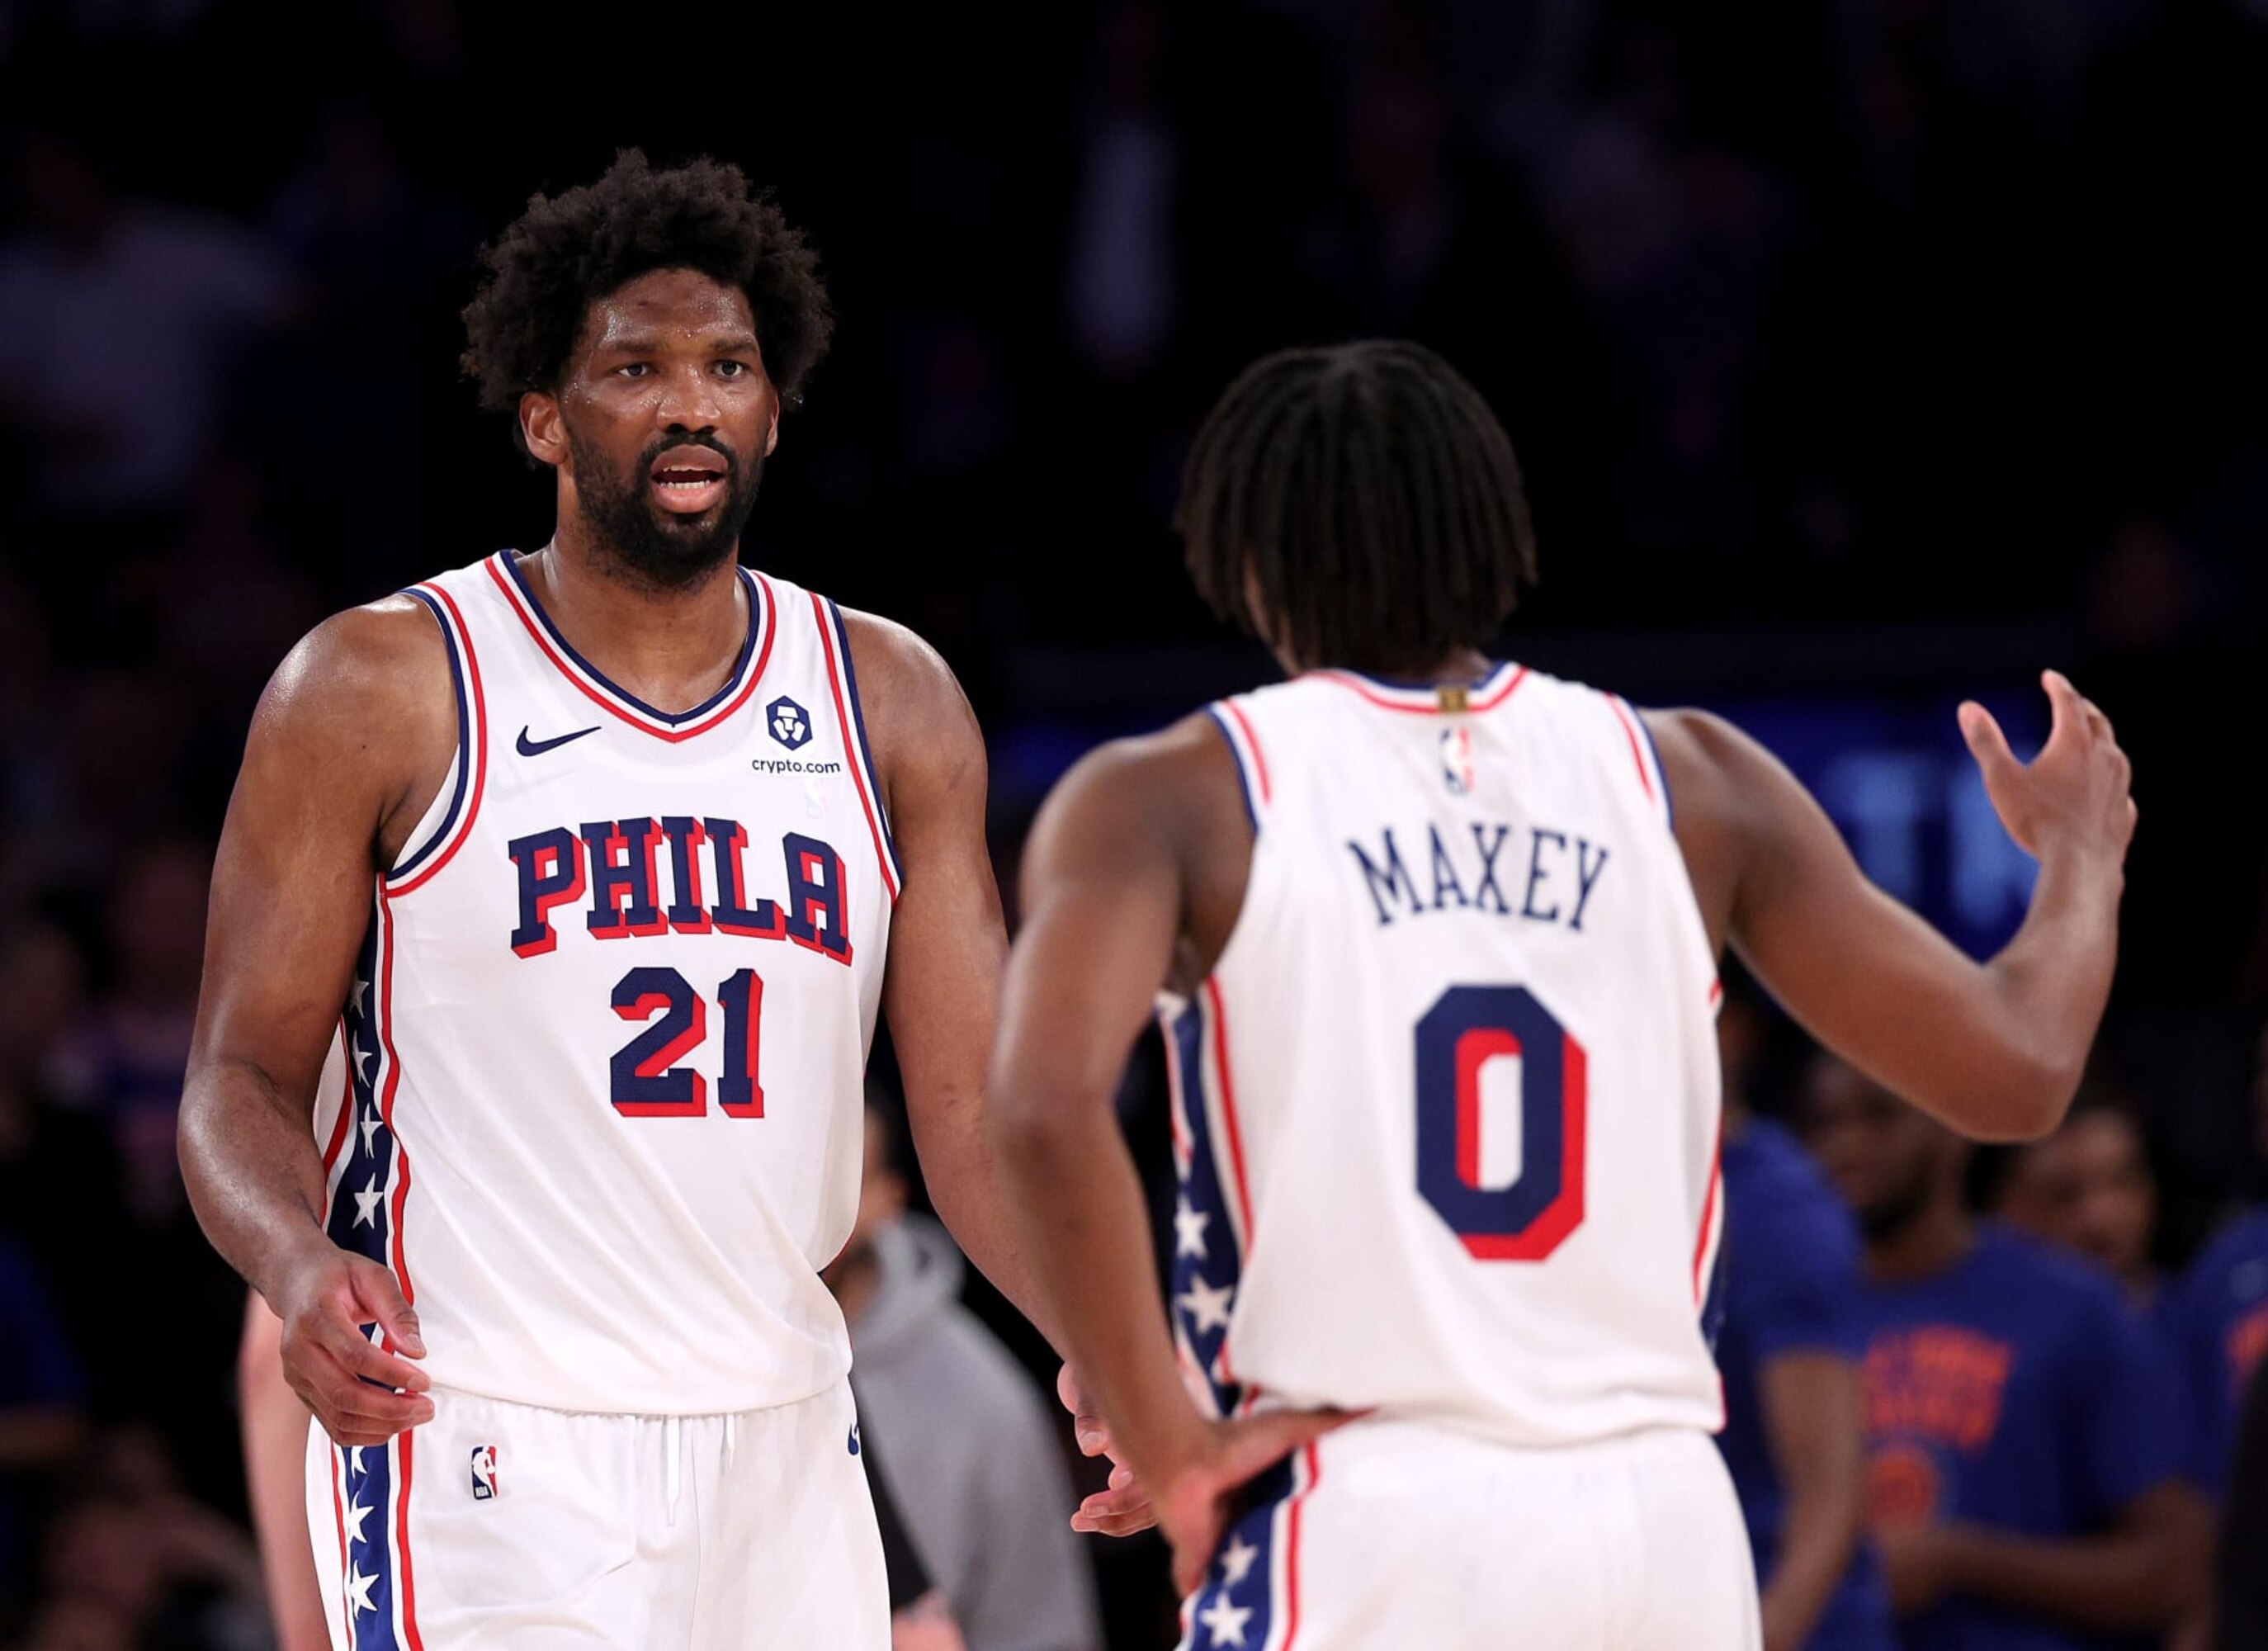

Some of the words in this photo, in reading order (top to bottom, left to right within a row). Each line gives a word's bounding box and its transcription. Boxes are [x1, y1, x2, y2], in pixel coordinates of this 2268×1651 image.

[752, 759, 840, 773] crypto.com
[508, 816, 853, 967] PHILA
[1347, 822, 1609, 931] MAXEY
[611, 967, 764, 1118] 21
[1415, 983, 1588, 1261] 0
